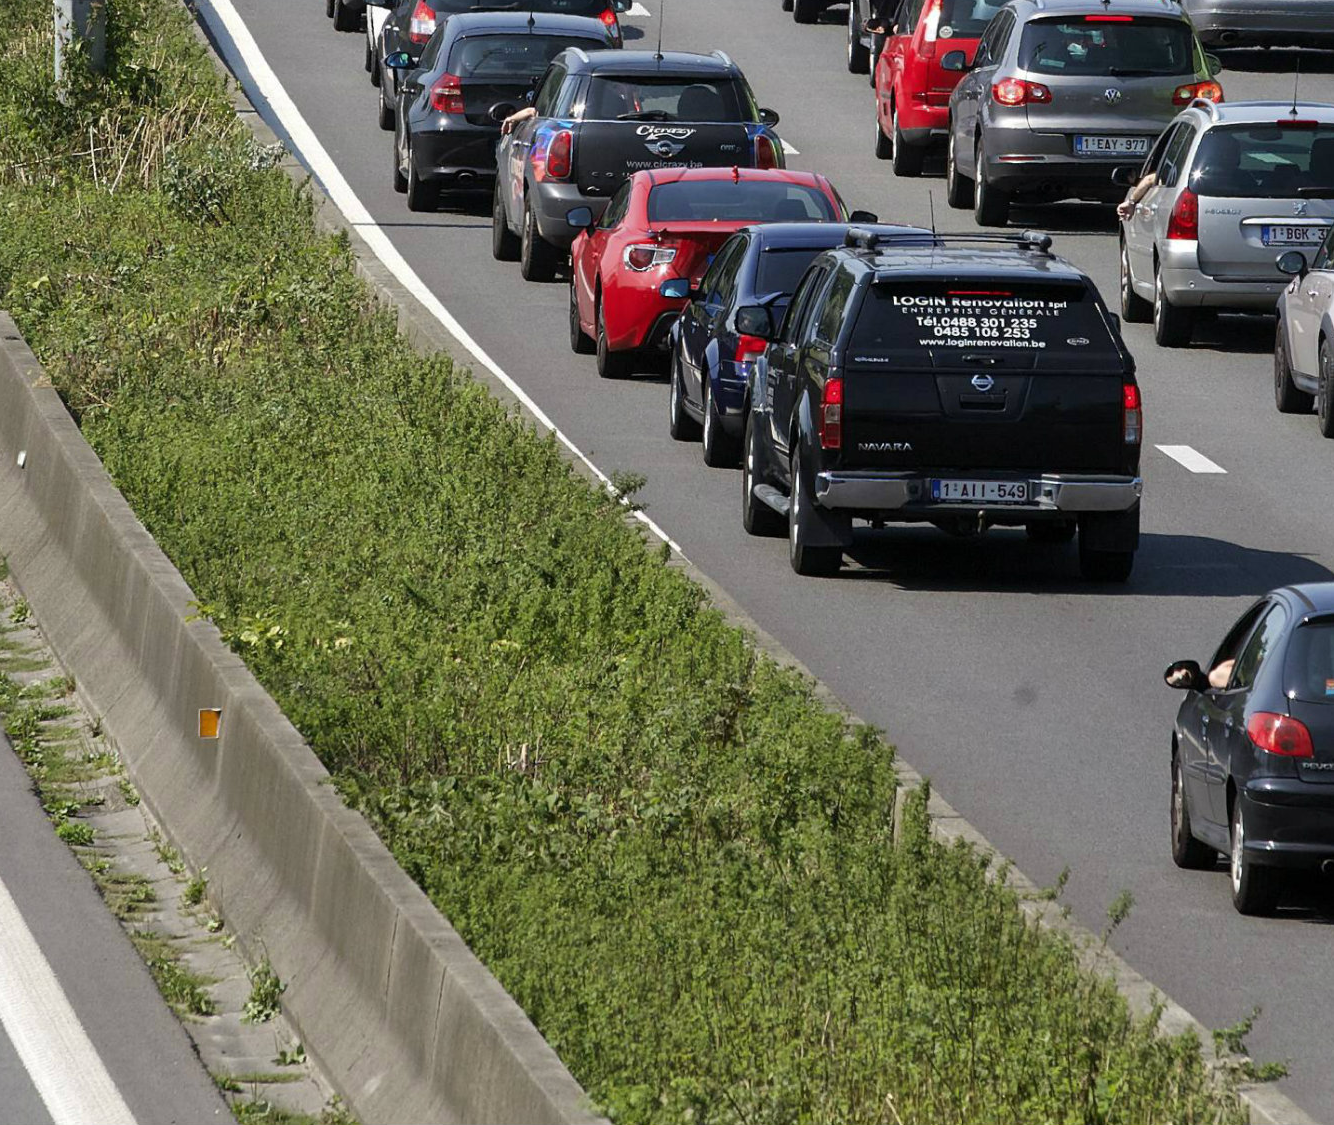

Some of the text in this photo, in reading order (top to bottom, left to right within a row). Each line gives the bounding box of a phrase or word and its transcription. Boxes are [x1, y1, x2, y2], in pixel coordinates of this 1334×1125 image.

[1084, 138, 1146, 150] 1-EAY-977
[626, 160, 703, 168] www.cicrazy.be
[1271, 227, 1329, 240] 1-BGK-3
[893, 296, 946, 306] LOGIN
[952, 297, 1044, 308] Renovation
[902, 307, 1059, 316] ENTREPRISE GÉNÉRALE
[981, 318, 1005, 328] 301
[1011, 319, 1037, 329] 235
[934, 327, 1031, 338] 0485 106 253
[919, 338, 1046, 348] www.loginrenovation.be
[858, 442, 913, 451] NAVARA
[943, 483, 1026, 499] 1-AII-549
